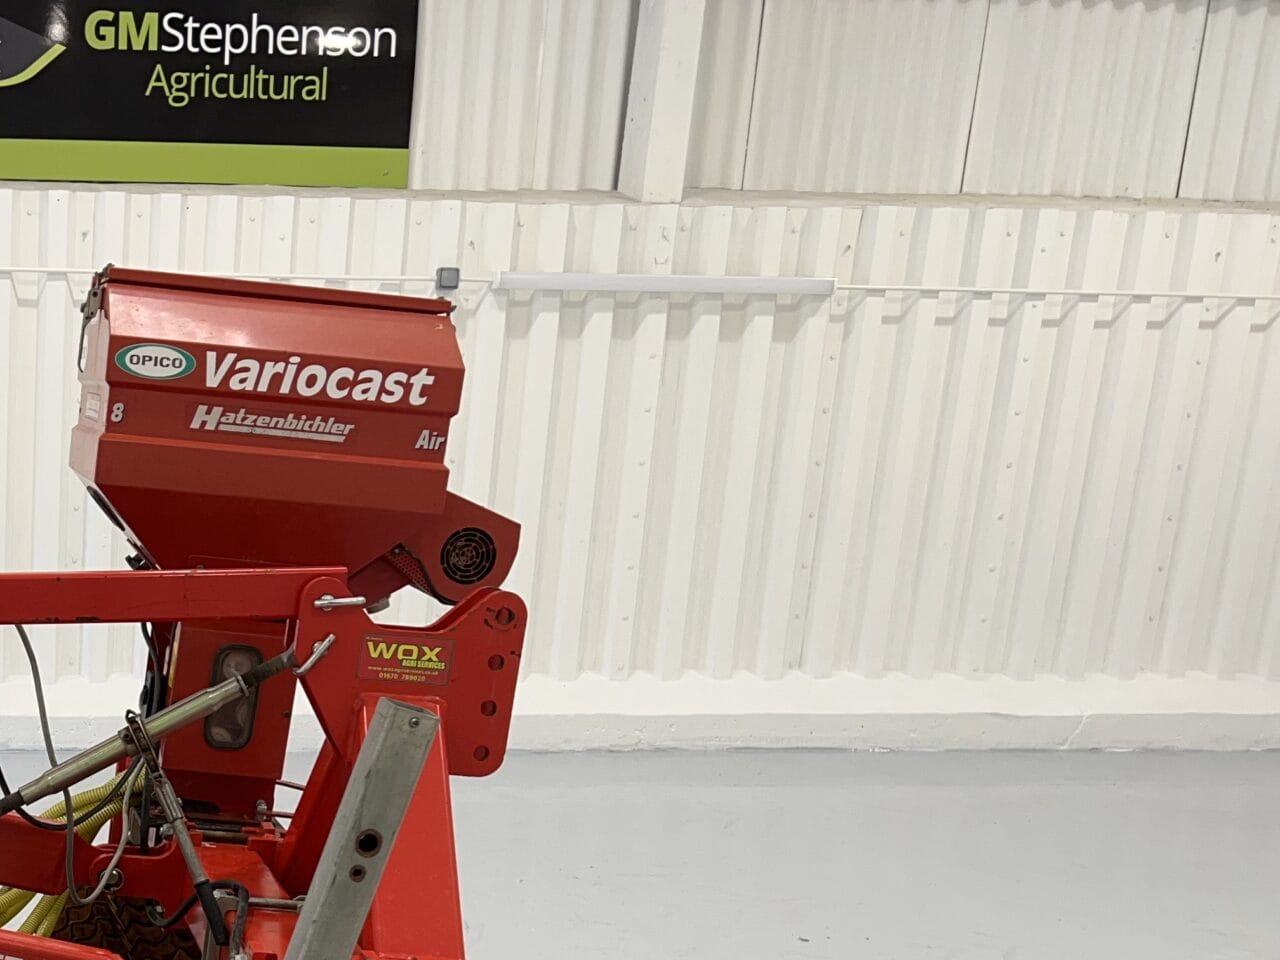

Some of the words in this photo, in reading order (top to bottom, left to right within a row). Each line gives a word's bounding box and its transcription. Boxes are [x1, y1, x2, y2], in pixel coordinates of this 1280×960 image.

[145, 64, 328, 107] Agricultural
[128, 353, 184, 369] OPICO
[204, 350, 436, 406] Variocast
[110, 402, 125, 423] 8
[189, 404, 355, 437] Hatzenbichler
[415, 429, 446, 451] Air
[367, 641, 443, 662] WOX
[417, 660, 446, 670] SERVICES
